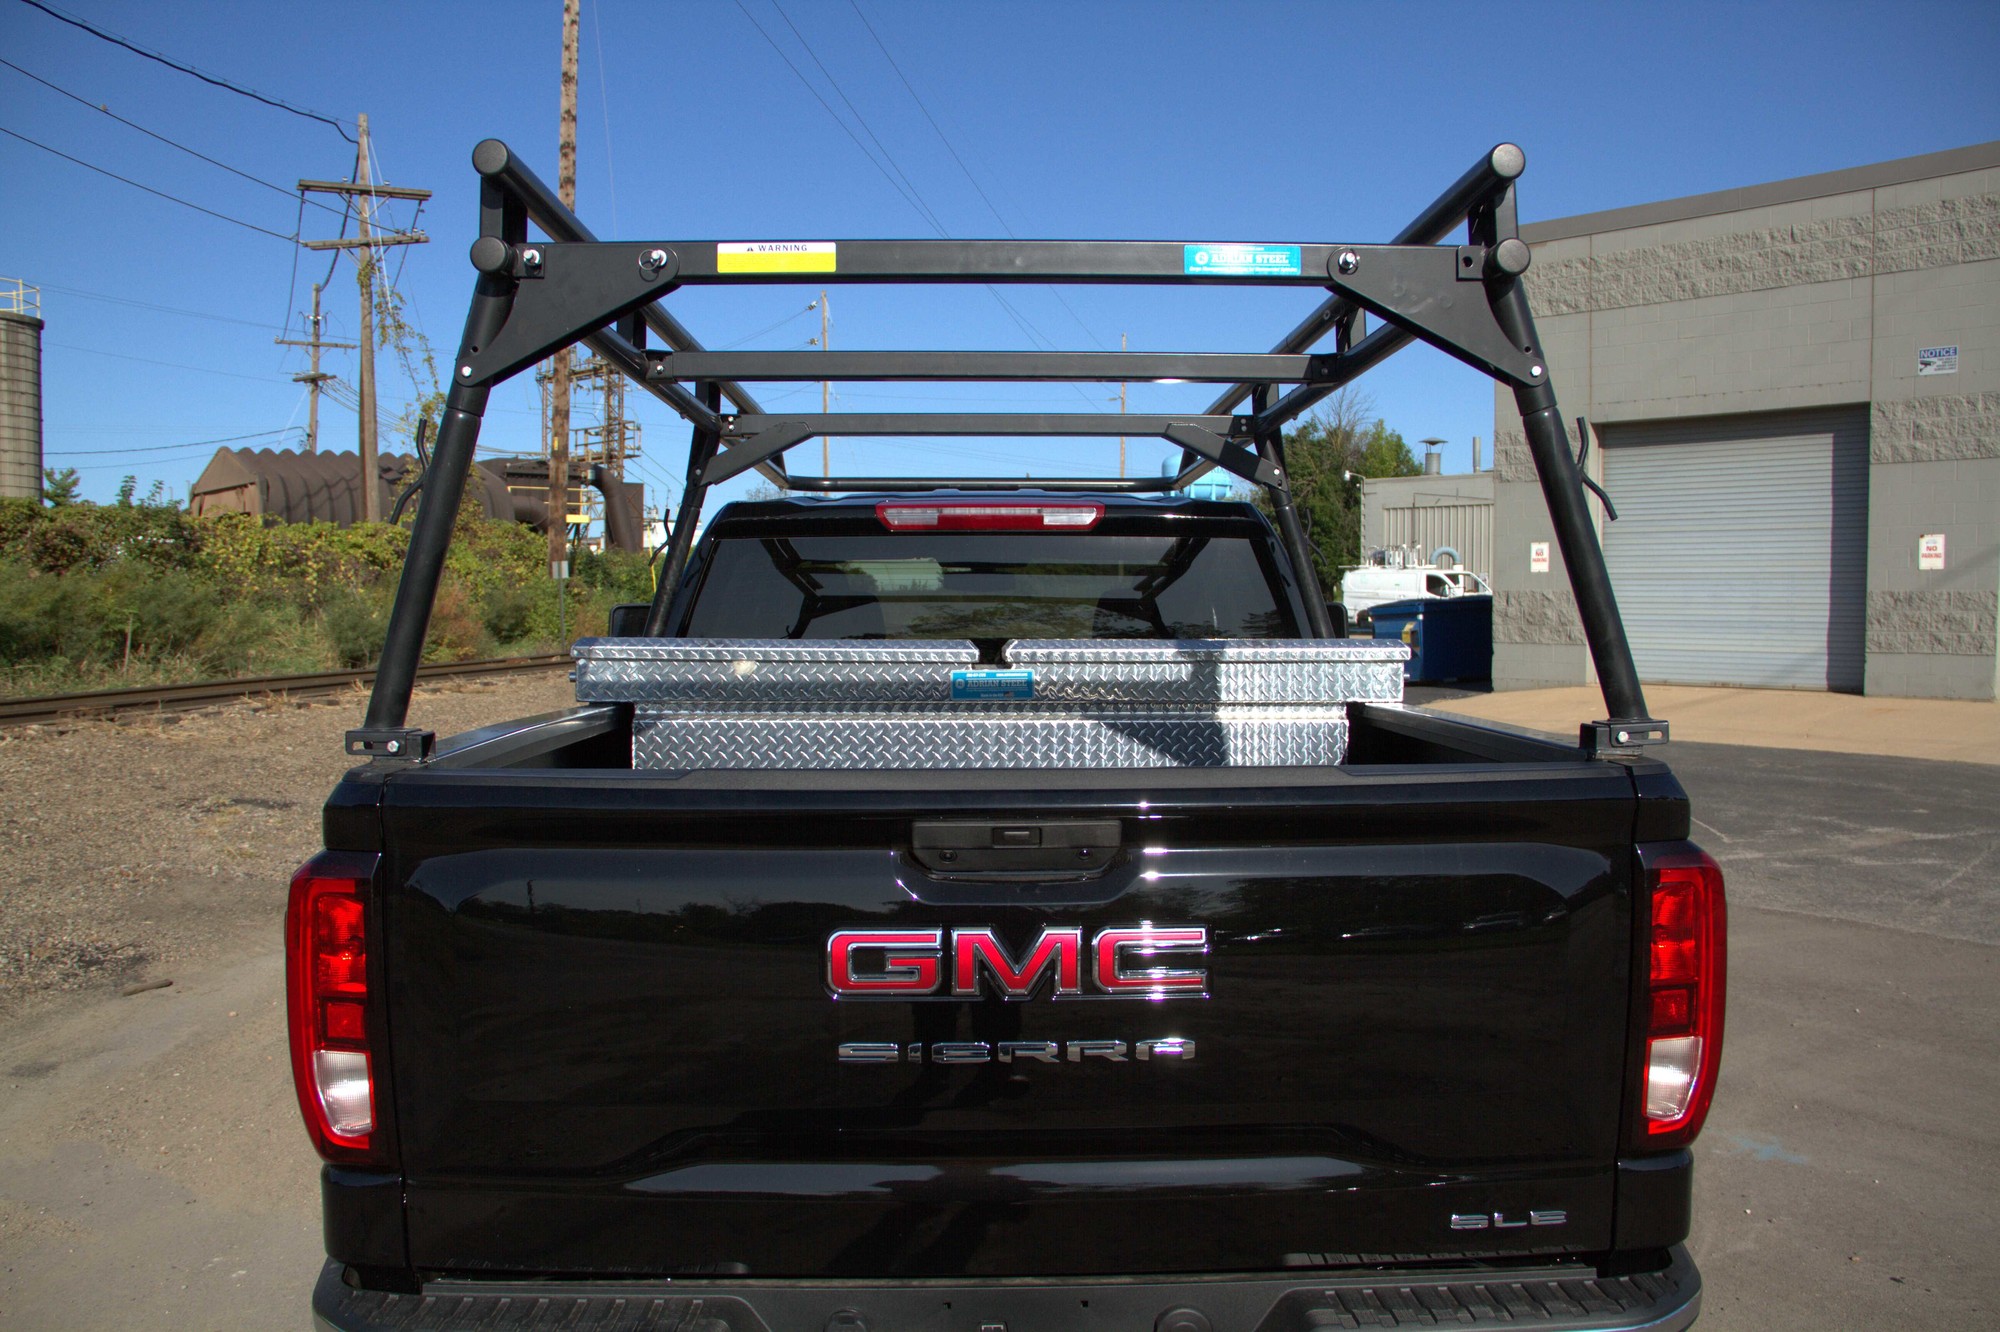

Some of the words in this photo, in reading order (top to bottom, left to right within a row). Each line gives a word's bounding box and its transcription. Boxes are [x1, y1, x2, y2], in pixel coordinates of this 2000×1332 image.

[758, 244, 808, 252] WARNING
[1256, 254, 1289, 264] STEEL
[1921, 347, 1956, 358] NOTICE
[827, 927, 1208, 997] GMC
[838, 1038, 1196, 1064] SIERRA
[1450, 1210, 1567, 1230] SLE
